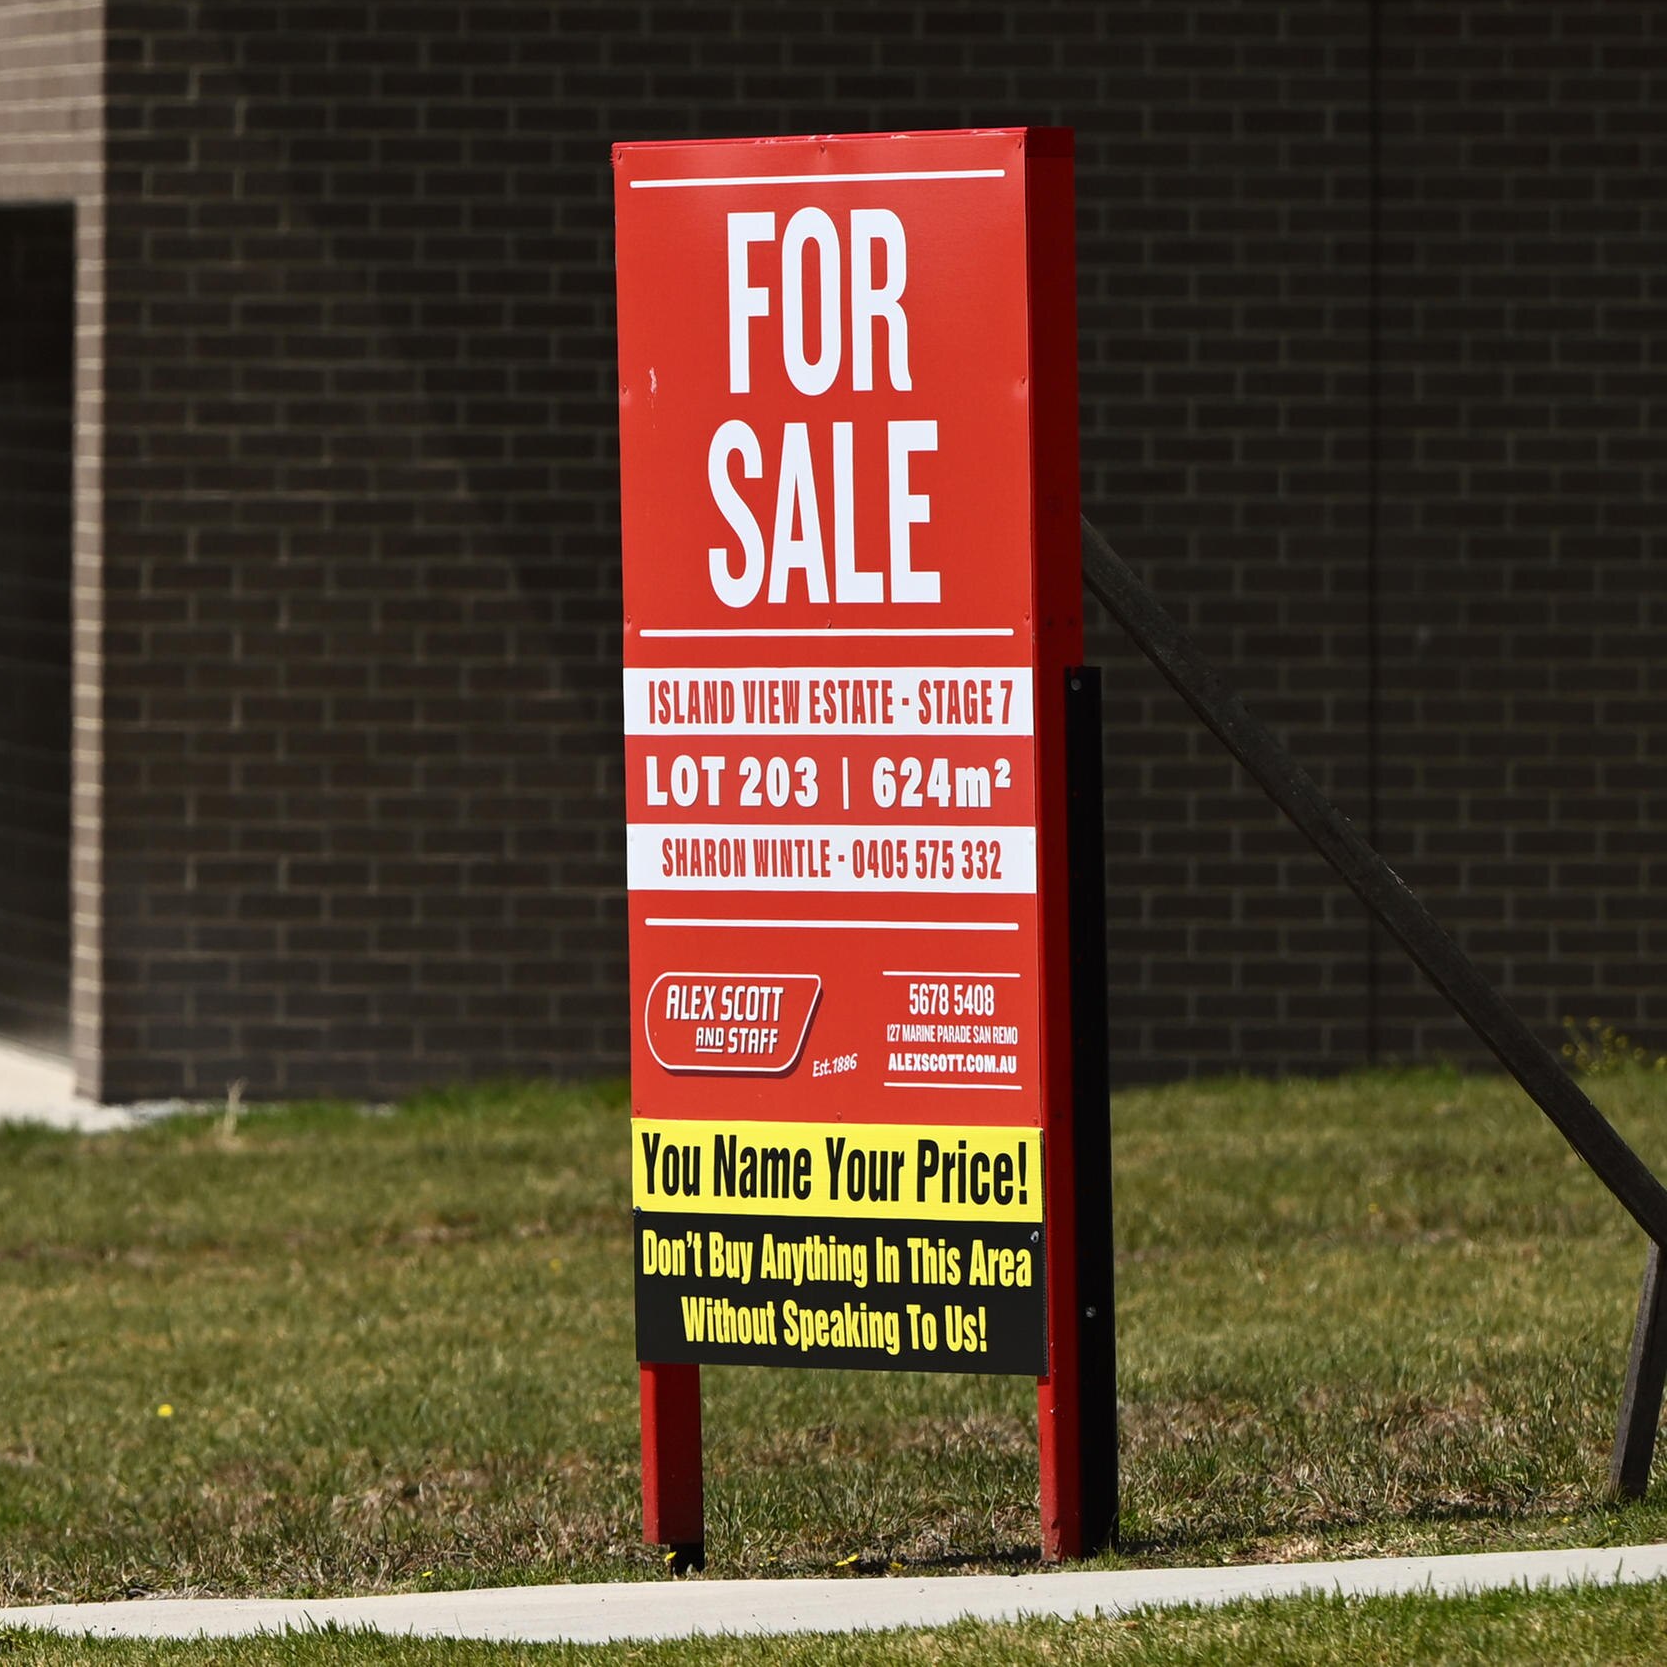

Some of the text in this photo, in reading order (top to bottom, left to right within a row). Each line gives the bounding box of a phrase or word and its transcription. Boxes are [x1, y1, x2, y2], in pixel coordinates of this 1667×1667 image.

[727, 206, 912, 396] FOR
[707, 419, 941, 608] SALE
[649, 680, 735, 724] ISLAND
[743, 680, 800, 724] VIEW
[809, 679, 894, 724] ESTATE
[918, 679, 992, 724] STAGE
[1000, 680, 1013, 724] 7
[646, 754, 725, 807] LOT
[739, 756, 819, 807] 203
[662, 838, 746, 877] SHARON
[753, 839, 831, 878] WINTLE
[852, 839, 908, 879] 0405
[916, 840, 954, 879] 575
[962, 840, 1002, 879] 332
[666, 984, 784, 1022] ALEX SCOTT
[909, 983, 995, 1016] 5678 5408
[696, 1027, 778, 1054] AND STAFF
[887, 1024, 1018, 1045] 127 MARINE PARADE SAN REMO
[888, 1053, 1017, 1074] ALEXSCOTT.COM.AU
[641, 1132, 1027, 1205] You Name Your Price!
[642, 1229, 1032, 1288] Don't Buy Anything In This Area
[681, 1296, 987, 1355] Without Speaking To Us!
